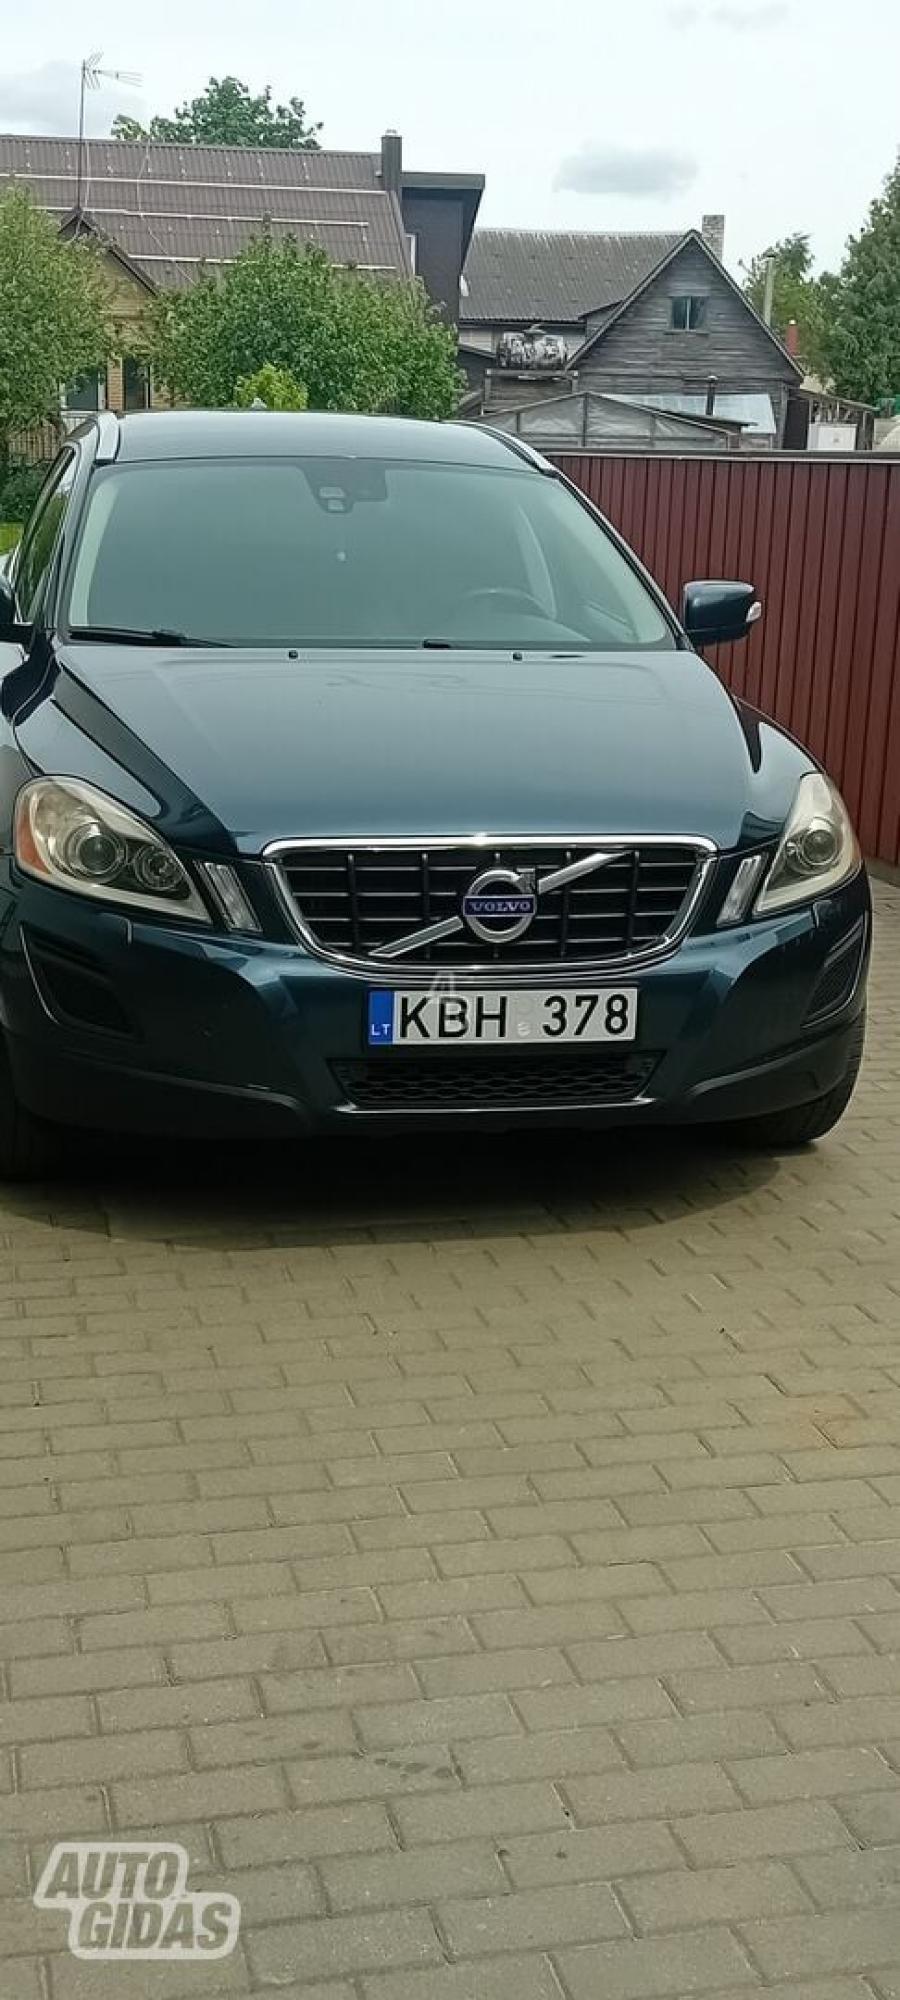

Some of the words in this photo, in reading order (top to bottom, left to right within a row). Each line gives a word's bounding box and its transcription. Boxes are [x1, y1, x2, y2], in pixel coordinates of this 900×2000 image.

[469, 901, 531, 912] VOLVO
[401, 995, 507, 1038] KBH
[542, 994, 628, 1036] 378
[371, 1024, 389, 1036] LT
